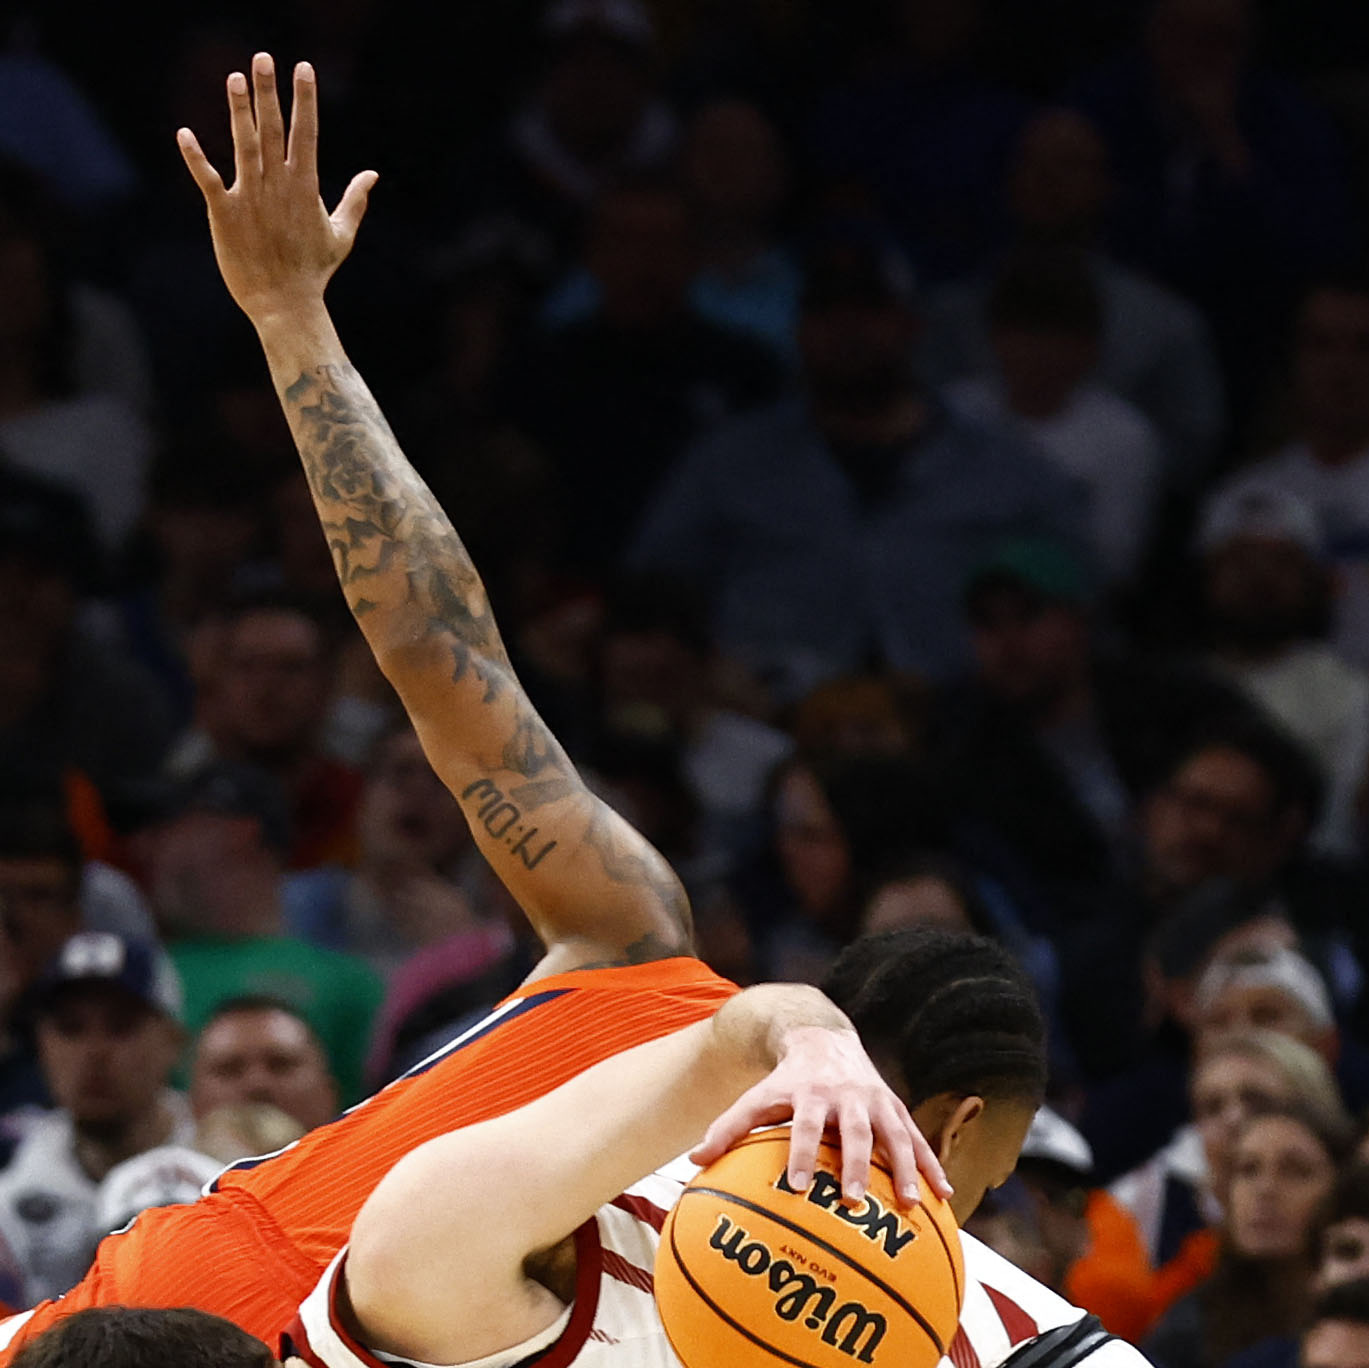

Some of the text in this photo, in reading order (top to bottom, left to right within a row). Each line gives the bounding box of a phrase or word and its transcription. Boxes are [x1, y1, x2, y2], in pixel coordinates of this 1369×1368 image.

[708, 1212, 889, 1365] Wilson
[779, 1243, 838, 1283] EVO NXT
